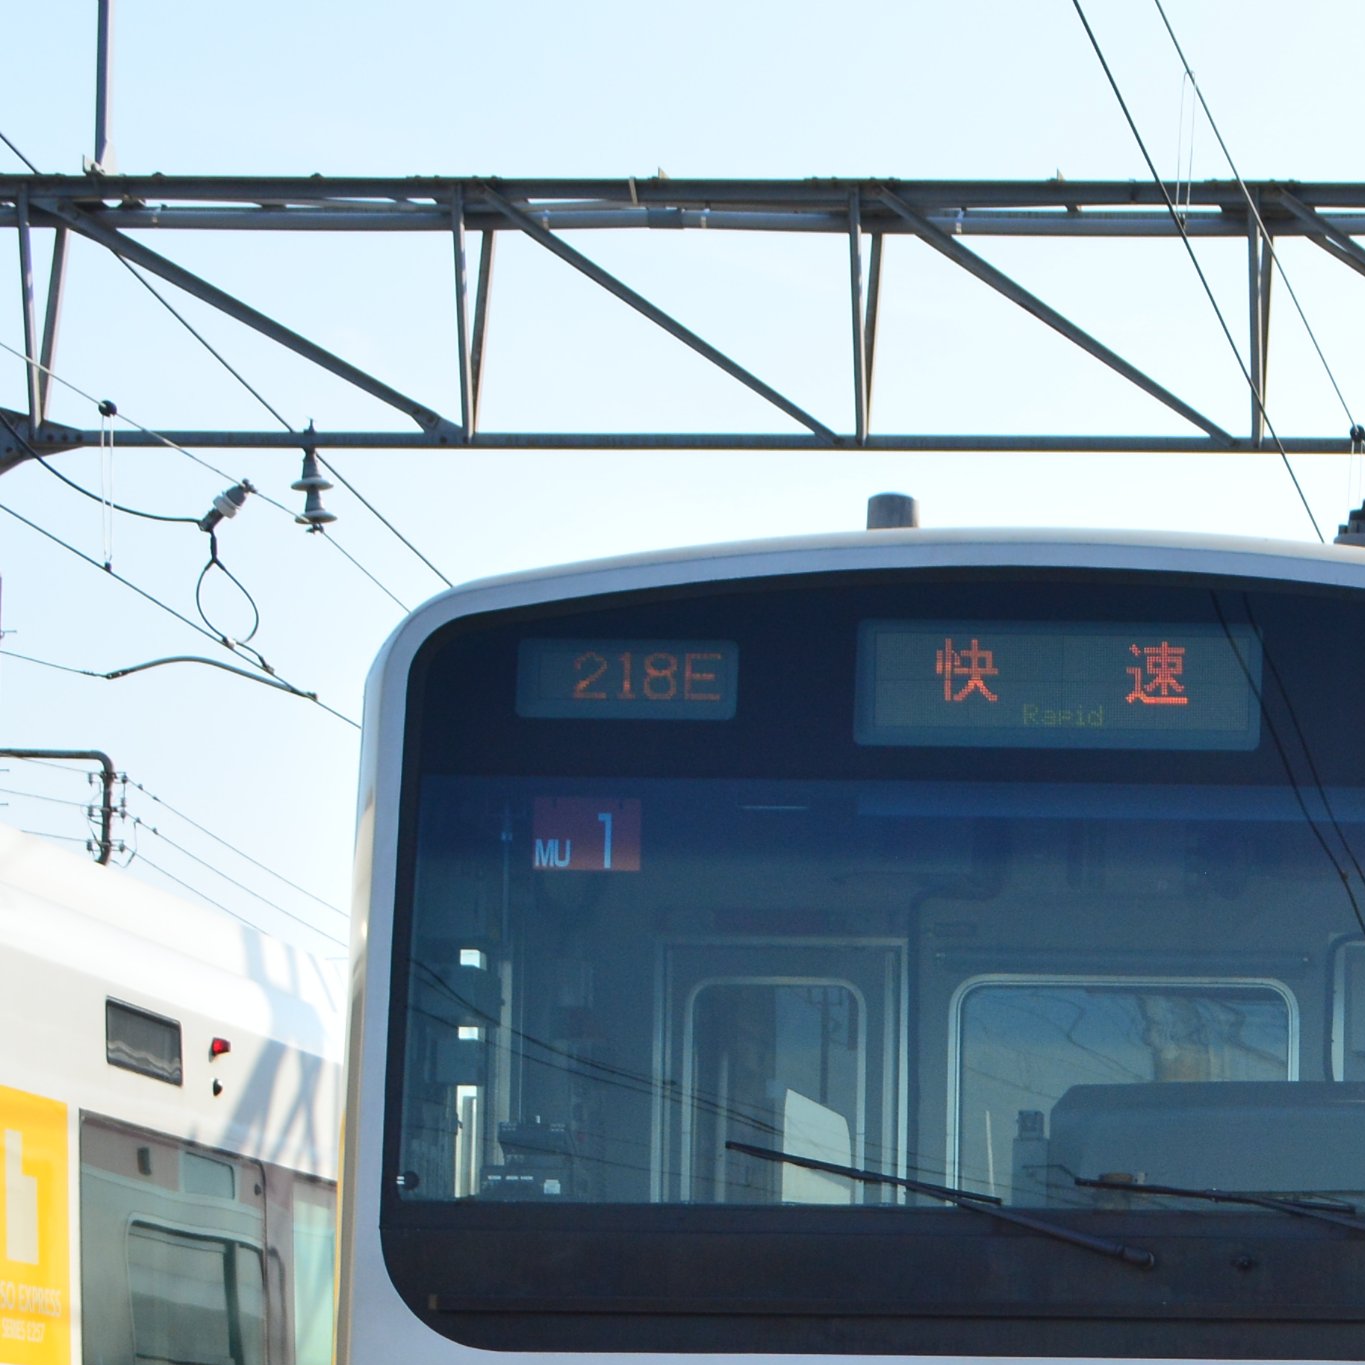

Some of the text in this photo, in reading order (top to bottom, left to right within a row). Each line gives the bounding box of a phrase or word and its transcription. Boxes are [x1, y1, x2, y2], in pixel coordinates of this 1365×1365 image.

[573, 651, 722, 700] 218E
[535, 812, 612, 869] MU 1
